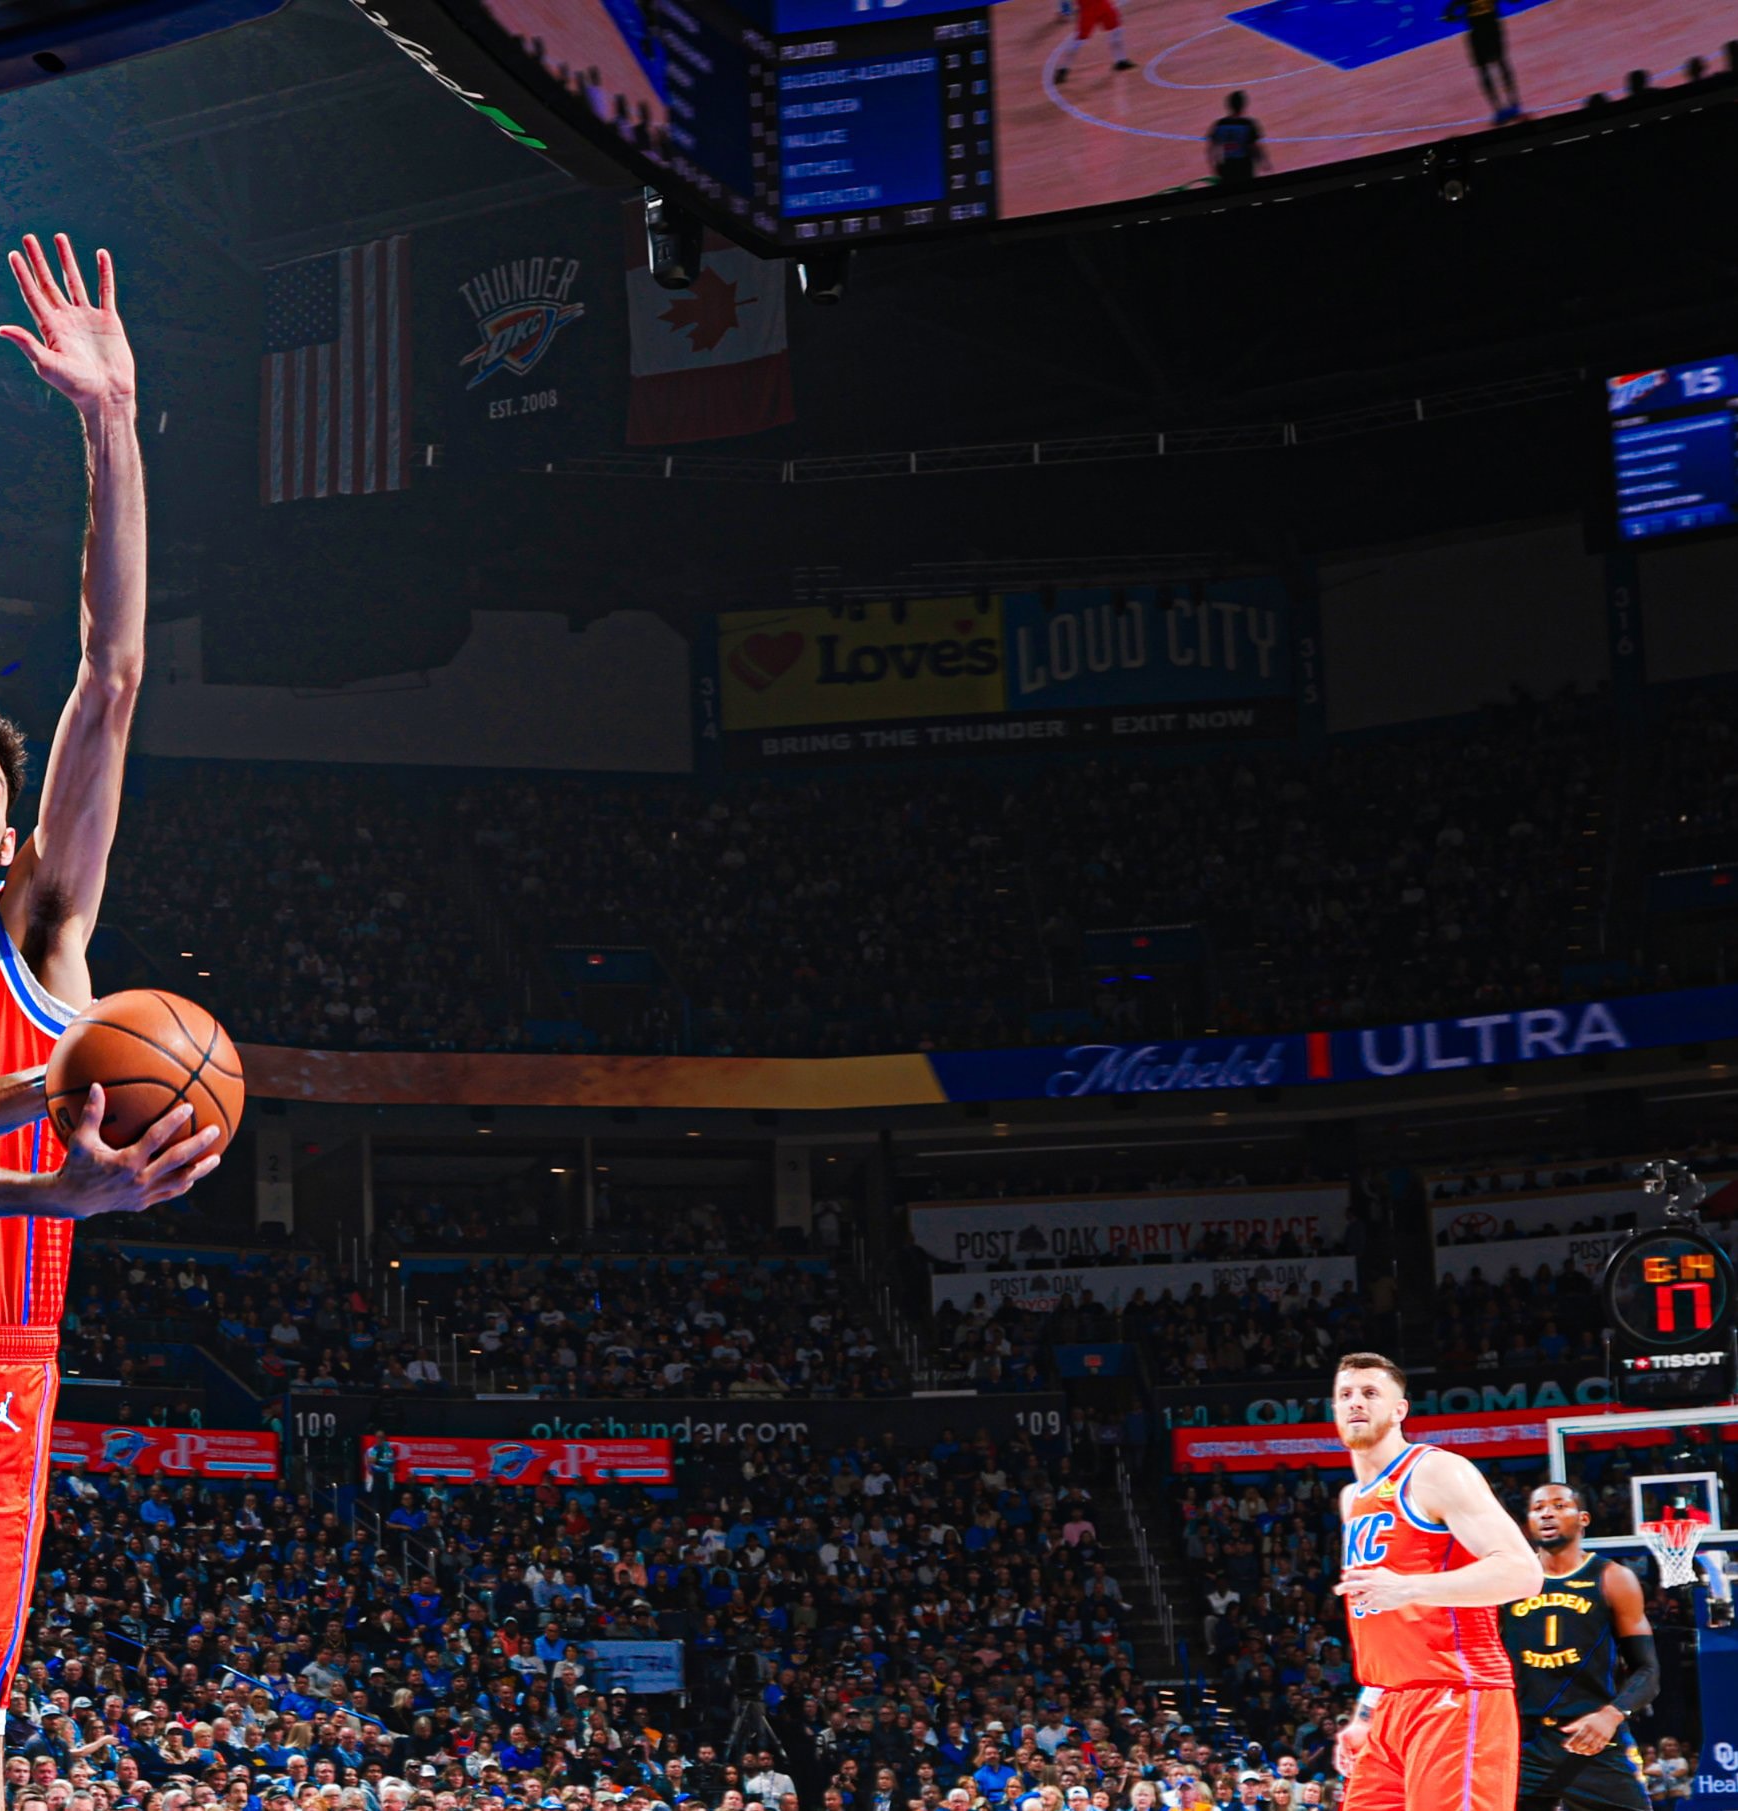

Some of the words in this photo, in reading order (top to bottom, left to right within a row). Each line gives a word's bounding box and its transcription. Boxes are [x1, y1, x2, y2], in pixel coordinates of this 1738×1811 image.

[458, 256, 580, 319] THUNDER
[485, 313, 543, 366] OKC
[1676, 365, 1725, 397] 15
[489, 397, 518, 420] EST.
[520, 389, 559, 415] 2008
[1016, 600, 1146, 695] LOUD
[1166, 597, 1276, 679] CITY
[700, 677, 718, 739] 314
[762, 733, 852, 756] BRING
[860, 728, 918, 749] THE
[925, 719, 1067, 747] THUNDER
[1111, 713, 1179, 735] EXIT
[1186, 709, 1255, 731] NOW
[1046, 1043, 1286, 1098] Michelob
[1361, 1002, 1629, 1077] ULTRA
[954, 1230, 1014, 1260] POST
[1052, 1226, 1101, 1258] OAK
[1108, 1221, 1191, 1253] PARTY
[1570, 1239, 1611, 1260] POST
[990, 1277, 1028, 1297] POST
[1052, 1275, 1085, 1295] OAK
[1213, 1266, 1251, 1288] POST
[1275, 1264, 1308, 1285] OAK
[1649, 1351, 1725, 1370] TISSOT
[1163, 1404, 1209, 1430] 10
[1245, 1379, 1571, 1426] OKHOMA
[295, 1411, 337, 1438] 109
[529, 1415, 809, 1444] okchunder.com
[1015, 1410, 1061, 1436] 109
[1342, 1512, 1394, 1570] KC
[1512, 1592, 1593, 1618] GOLDEN
[1545, 1614, 1558, 1647] 1
[1522, 1647, 1581, 1669] STATE
